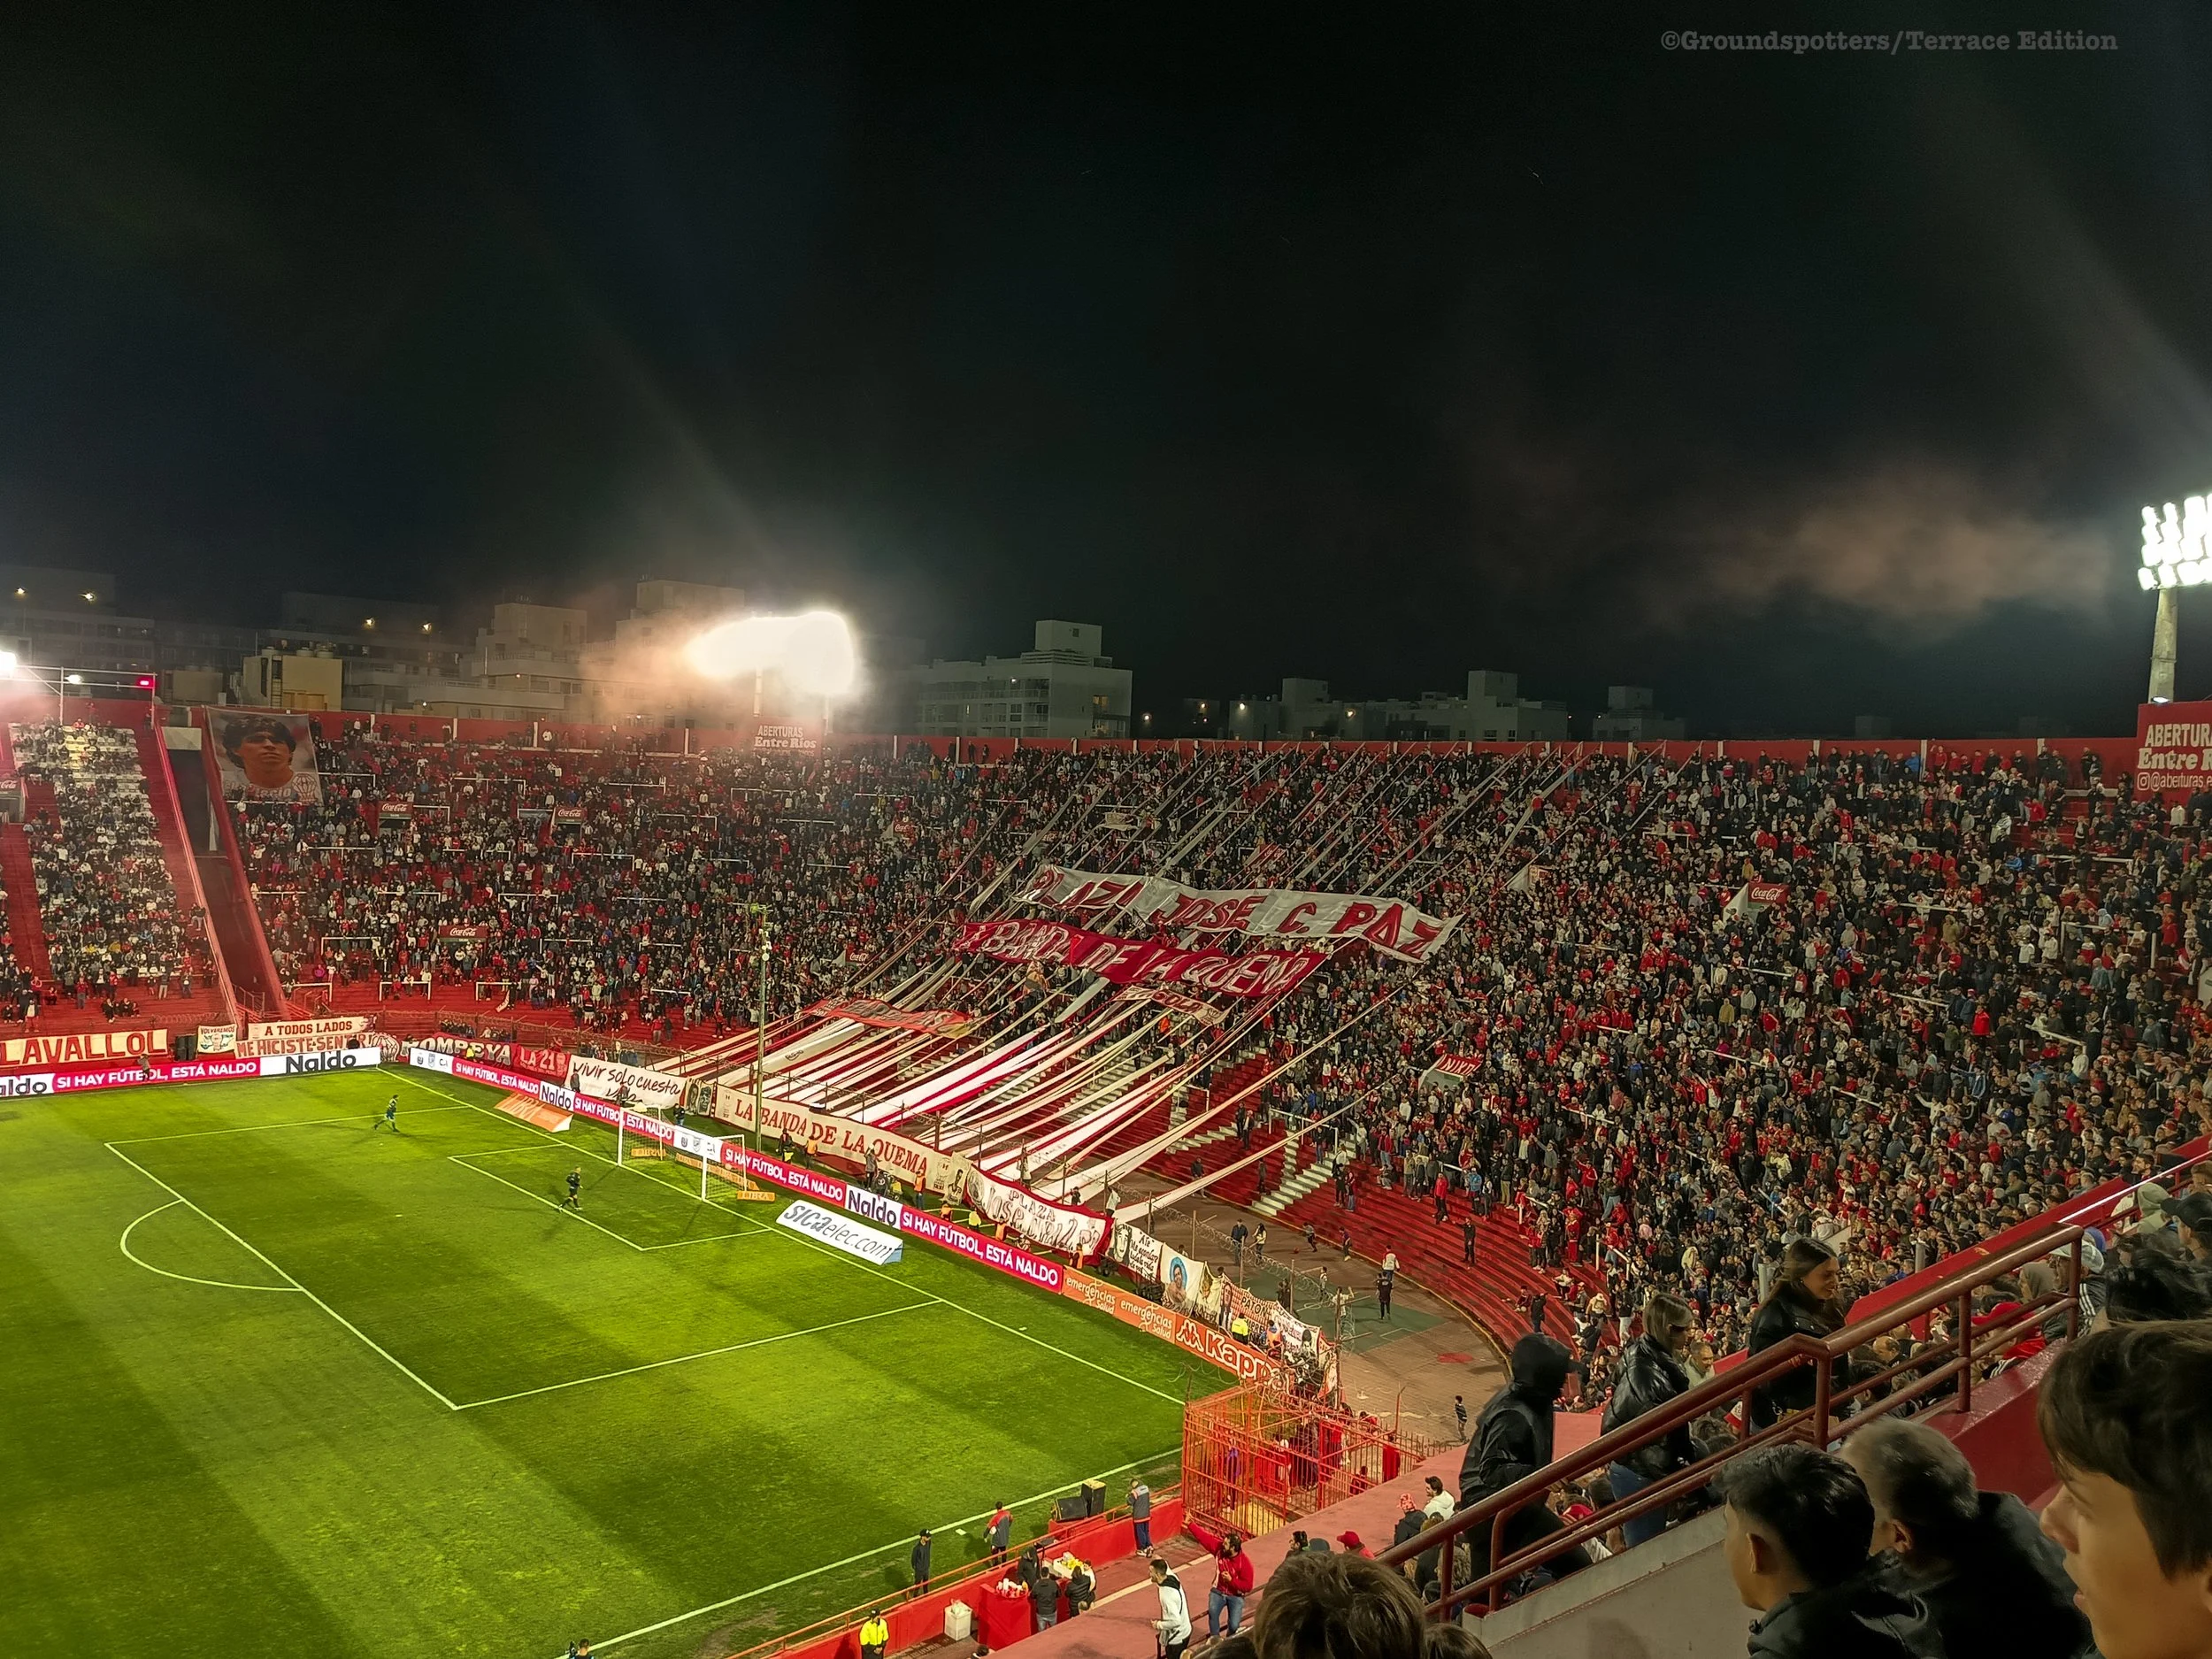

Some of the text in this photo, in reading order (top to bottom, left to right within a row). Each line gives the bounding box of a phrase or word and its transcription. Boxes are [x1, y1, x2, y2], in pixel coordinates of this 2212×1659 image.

[754, 737, 817, 749] Entre Ríos
[757, 725, 803, 737] ABERTURAS
[2145, 723, 2212, 747] ABERTUR
[2138, 748, 2198, 770] Entre
[1148, 893, 1268, 930] JOSE
[1327, 901, 1444, 960] PAZ
[1078, 941, 1143, 973] DE
[265, 1020, 352, 1036] A TODOS LADOS
[236, 1041, 255, 1058] ME
[257, 1037, 314, 1056] HICISTE
[520, 1046, 536, 1067] LA
[540, 1048, 556, 1071] 21
[57, 1077, 71, 1088] SI
[74, 1073, 105, 1087] HAY
[171, 1063, 205, 1079] ESTÁ
[209, 1062, 257, 1076] NALDO
[286, 1051, 357, 1074] Naldo
[456, 1063, 463, 1073] SI
[463, 1064, 475, 1076] HAY
[501, 1074, 517, 1087] ESTÁ
[518, 1079, 540, 1094] NALDO
[636, 1078, 681, 1095] cuesta
[541, 1085, 572, 1110] Naldo
[574, 1098, 582, 1110] SI
[582, 1100, 596, 1114] HAY
[645, 1118, 672, 1141] NALDO
[734, 1098, 928, 1175] LA BANDA DE LA QUEMA
[726, 1148, 733, 1162] SI
[734, 1153, 751, 1168] HAY
[752, 1156, 787, 1184] FÚTBOL,
[788, 1171, 810, 1190] ESTÁ
[811, 1179, 843, 1202] NALDO
[848, 1189, 897, 1227] Naldo
[1010, 1189, 1056, 1223] PLAZA
[902, 1211, 1059, 1286] SI HAY FÚTBOL, ESTÁ NALDO
[1066, 1277, 1116, 1305] emergencias
[1096, 1299, 1115, 1315] Salud
[1120, 1299, 1173, 1330] emergencias
[1153, 1324, 1171, 1340] Salud
